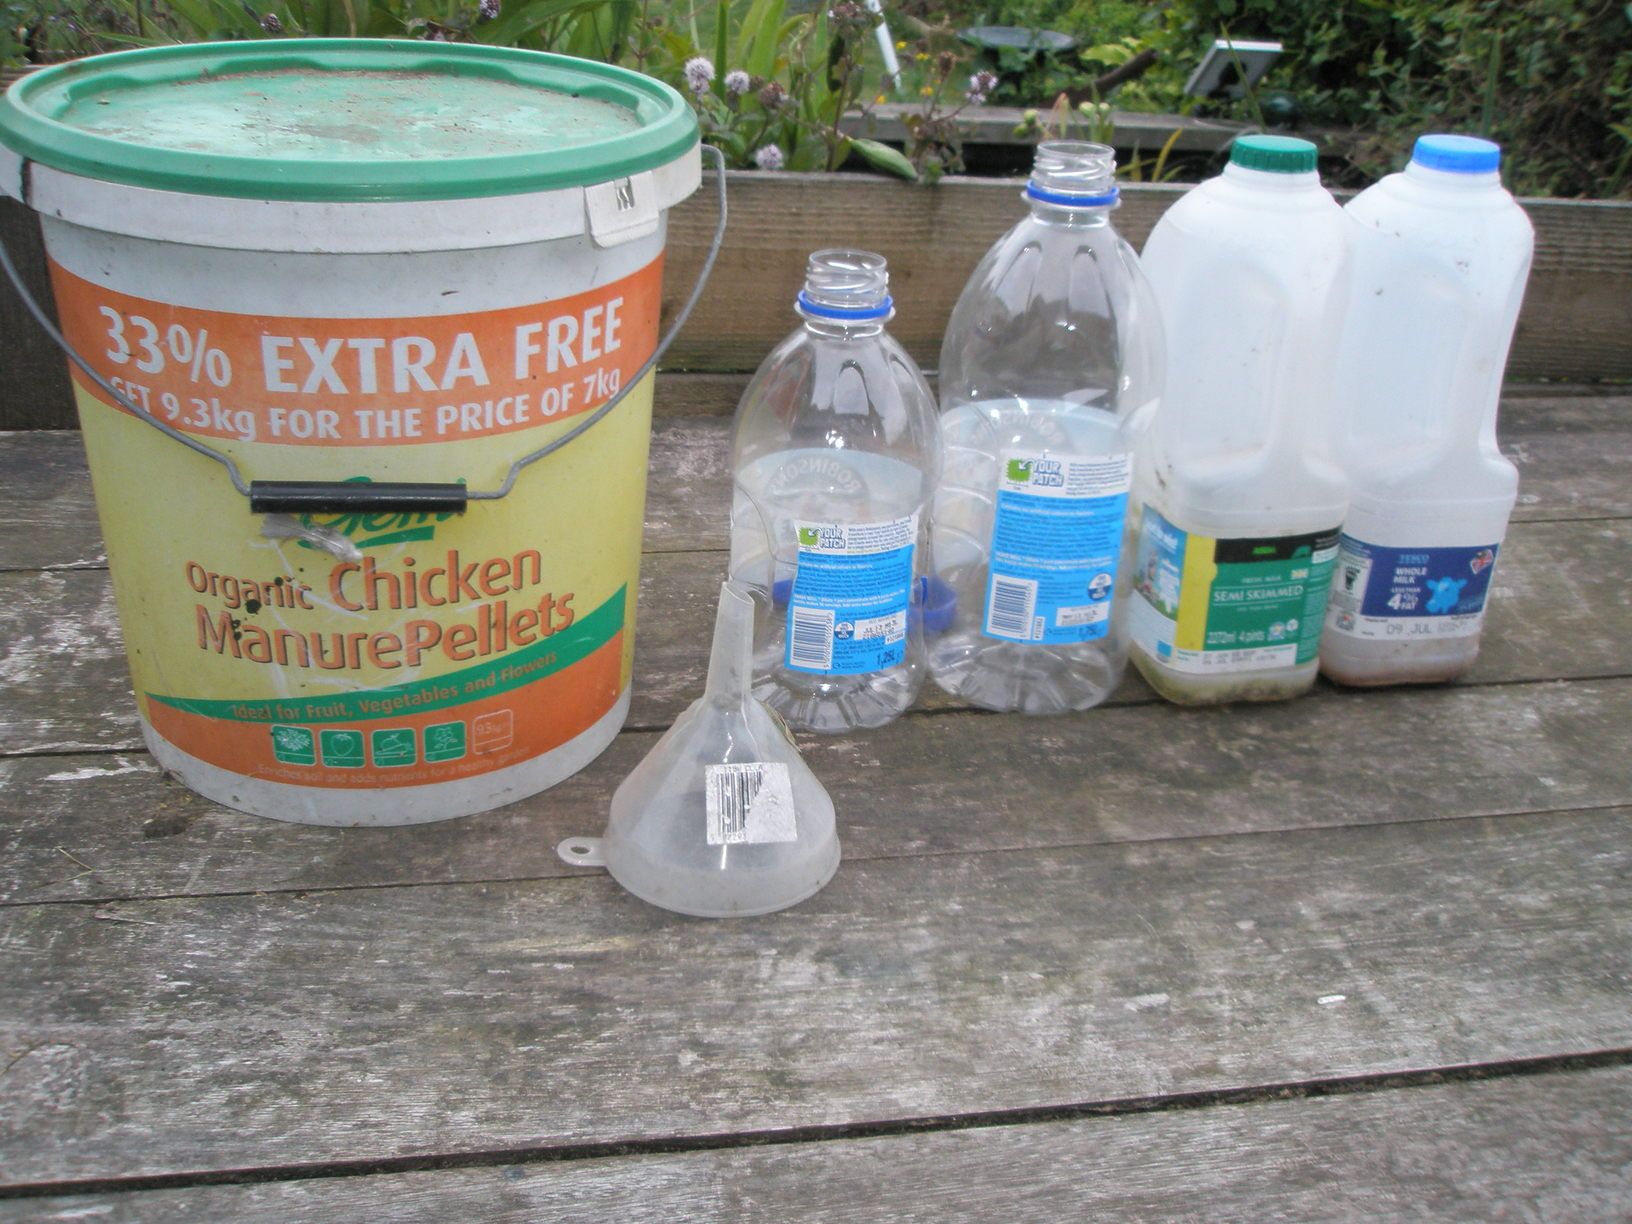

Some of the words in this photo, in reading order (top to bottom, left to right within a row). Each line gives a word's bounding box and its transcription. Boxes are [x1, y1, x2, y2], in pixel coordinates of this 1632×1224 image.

[99, 305, 233, 388] 33%
[261, 332, 490, 395] EXTRA
[515, 297, 624, 380] FREE
[160, 392, 257, 442] 9.3kg
[268, 407, 342, 439] FOR
[354, 408, 422, 439] THE
[436, 394, 530, 435] PRICE
[541, 382, 576, 416] OF
[583, 367, 622, 405] 7kg
[1033, 459, 1062, 475] YOUR
[1032, 473, 1064, 488] PATCH
[819, 527, 844, 540] YOUR
[819, 539, 846, 550] PATCH
[1396, 567, 1428, 576] WHOLE
[186, 560, 314, 610] Organic
[328, 549, 542, 611] Chicken
[1393, 576, 1416, 584] MILK
[1213, 590, 1244, 602] SEMI
[1247, 585, 1304, 601] SKIMMED
[233, 703, 273, 720] Ideal
[276, 703, 300, 719] for
[305, 701, 353, 719] Fruit,
[359, 685, 459, 715] Vegetables
[464, 671, 496, 693] and
[501, 651, 557, 682] Flowers
